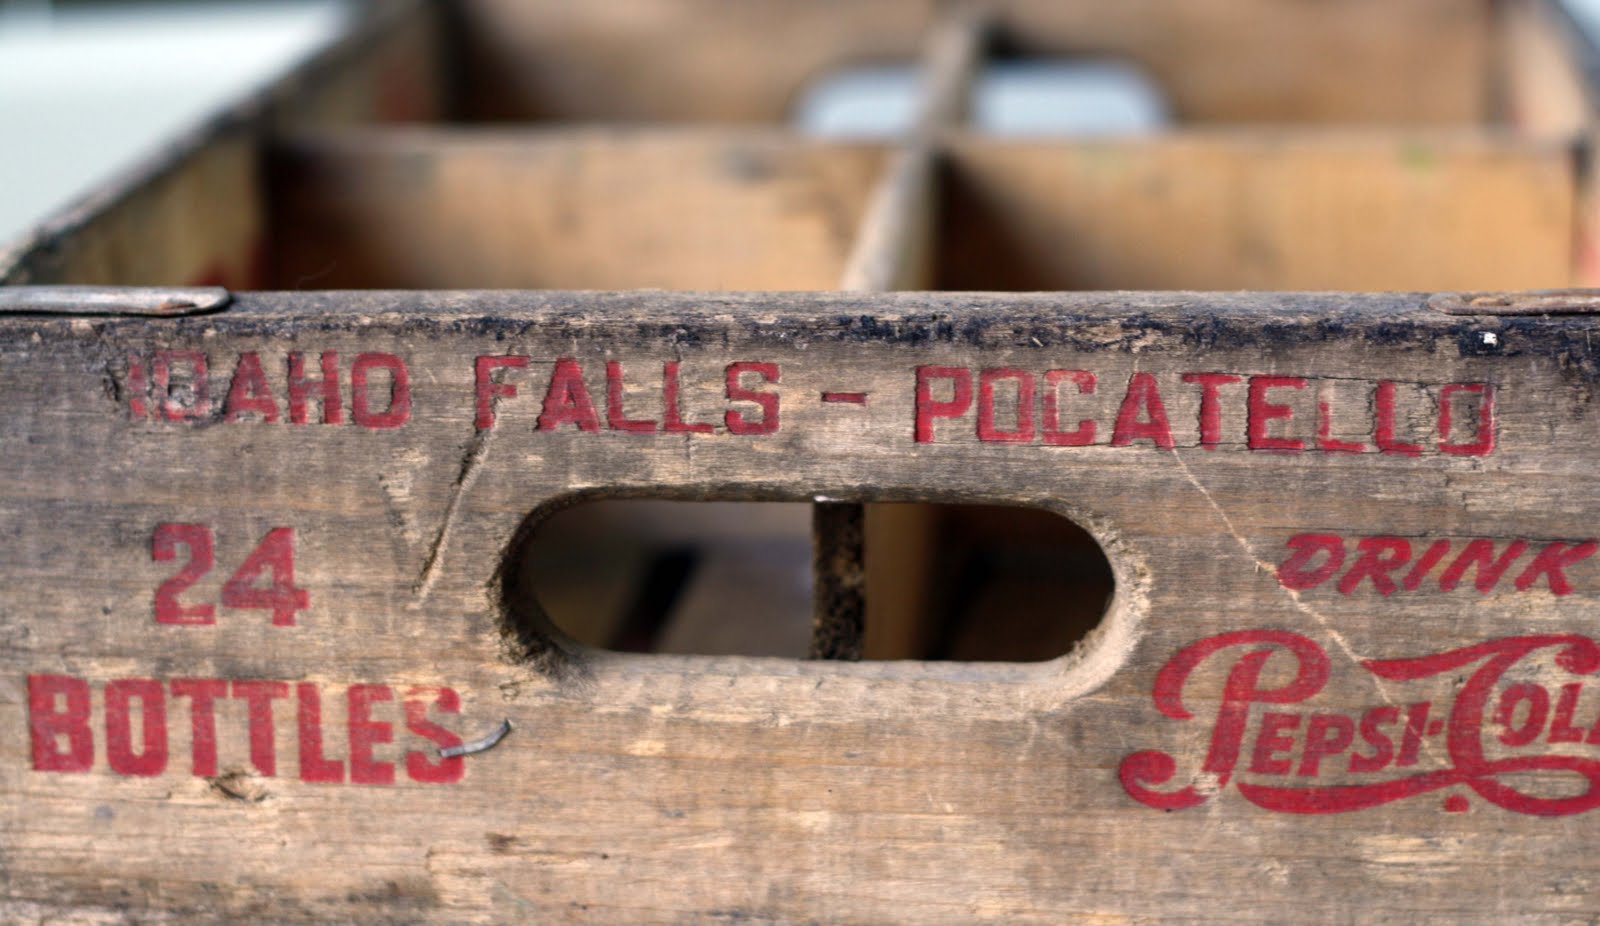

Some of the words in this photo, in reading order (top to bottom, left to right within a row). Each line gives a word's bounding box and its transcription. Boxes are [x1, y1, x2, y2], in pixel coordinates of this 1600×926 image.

[127, 350, 411, 429] IDAHO
[475, 356, 781, 435] FALLS
[914, 366, 1496, 456] POCATELLO
[152, 523, 311, 627] 24
[1277, 533, 1600, 597] DRINK
[27, 674, 466, 785] BOTTLES
[1119, 629, 1600, 815] PEPSI-COL
